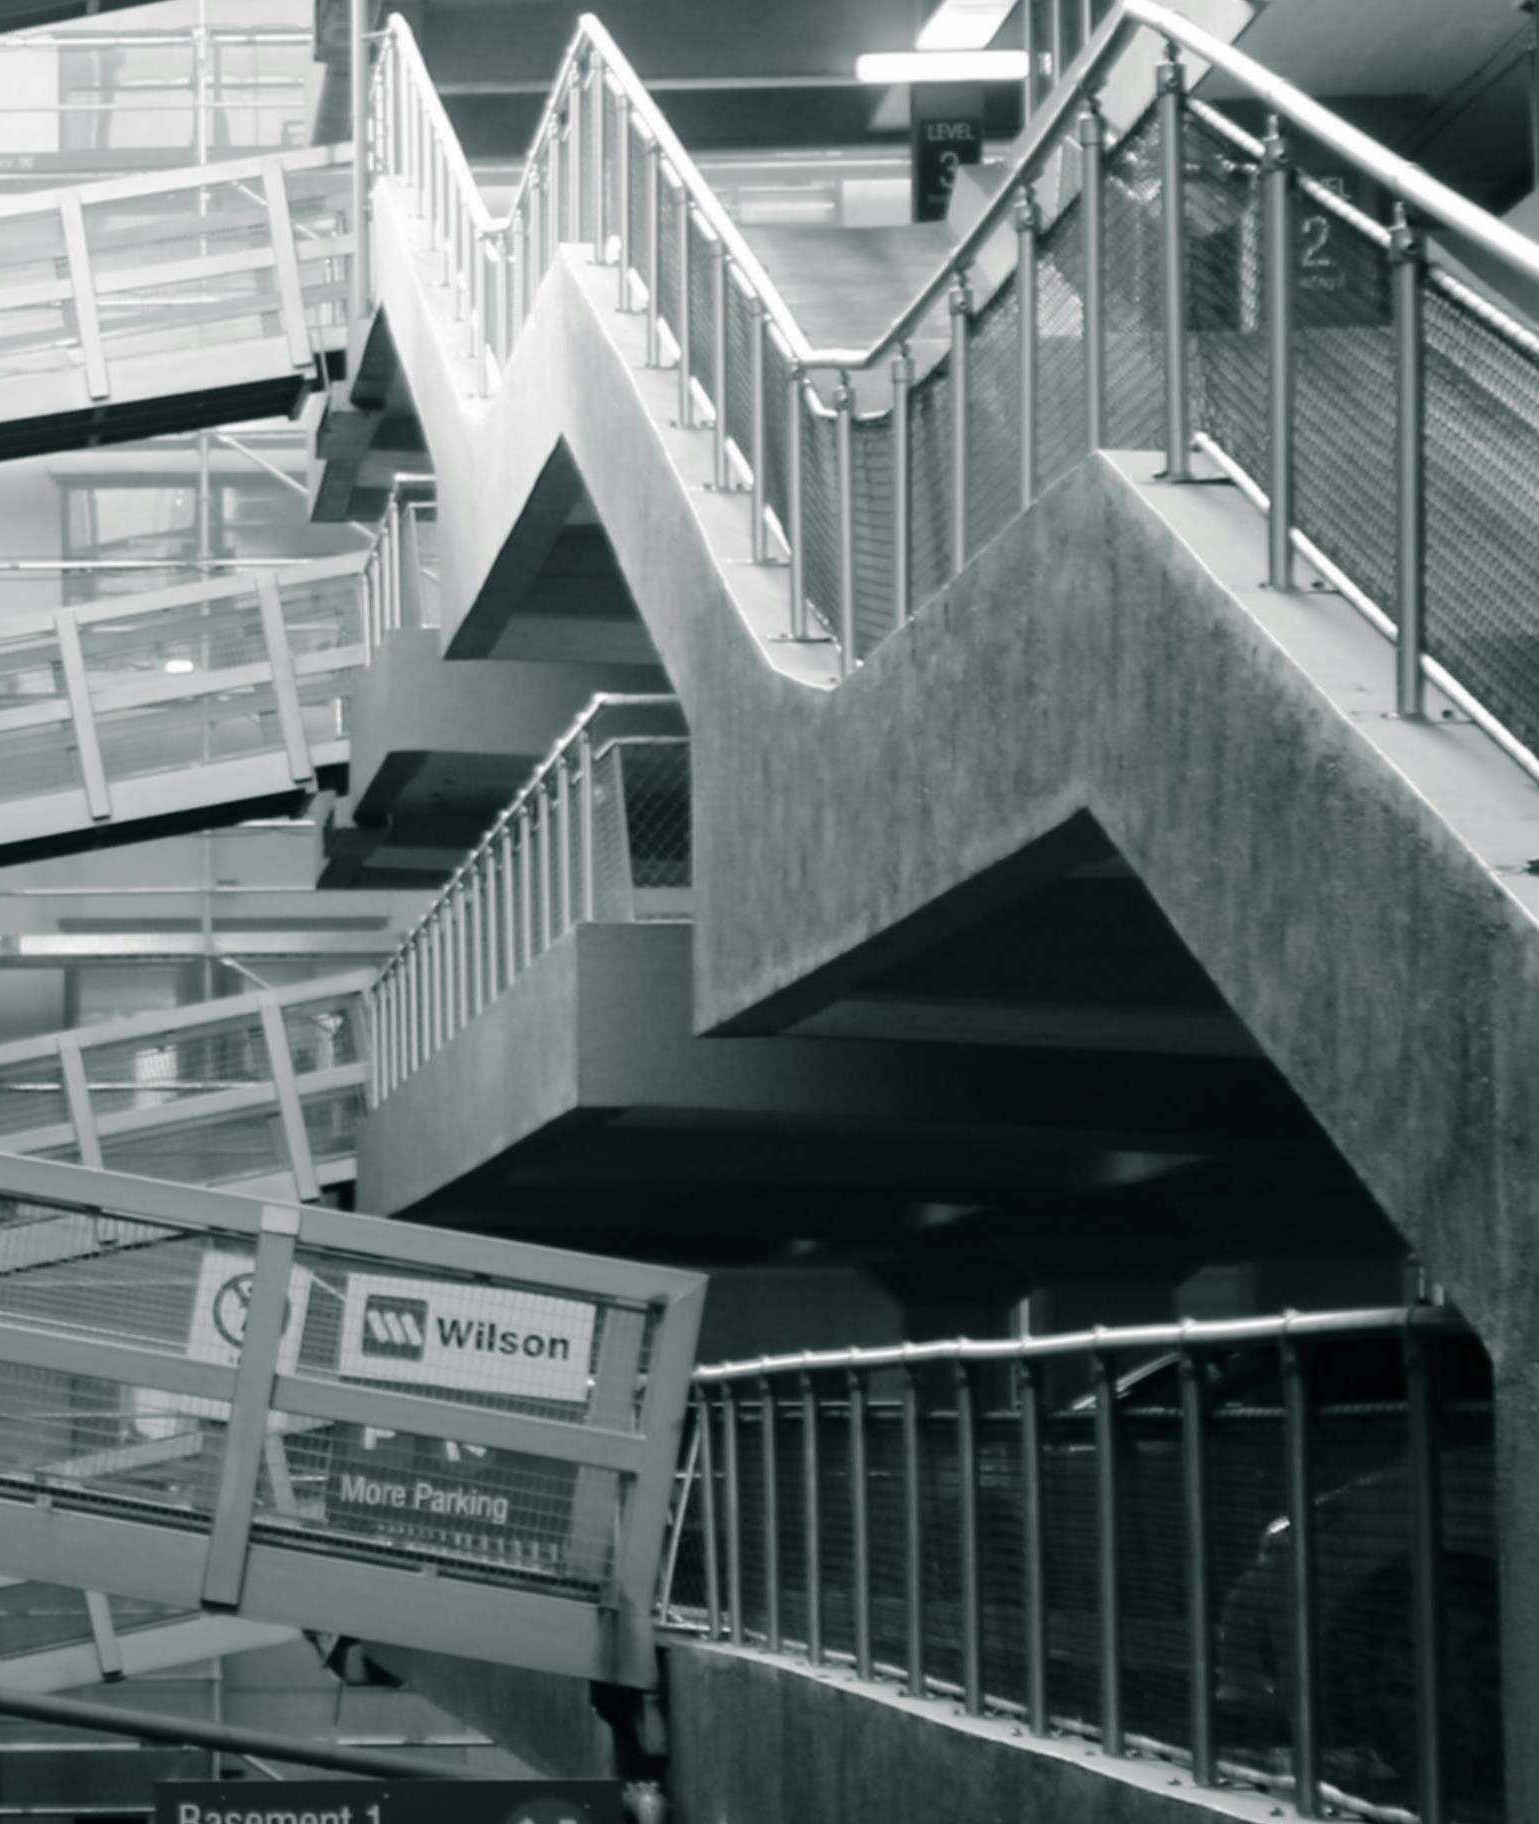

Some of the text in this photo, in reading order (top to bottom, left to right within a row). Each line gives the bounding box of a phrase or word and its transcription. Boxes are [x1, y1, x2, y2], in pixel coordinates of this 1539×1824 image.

[927, 120, 975, 141] LEVEL
[940, 150, 960, 189] 3
[1303, 215, 1331, 267] 2
[437, 1316, 571, 1360] Wilson
[340, 1473, 509, 1524] More Parking
